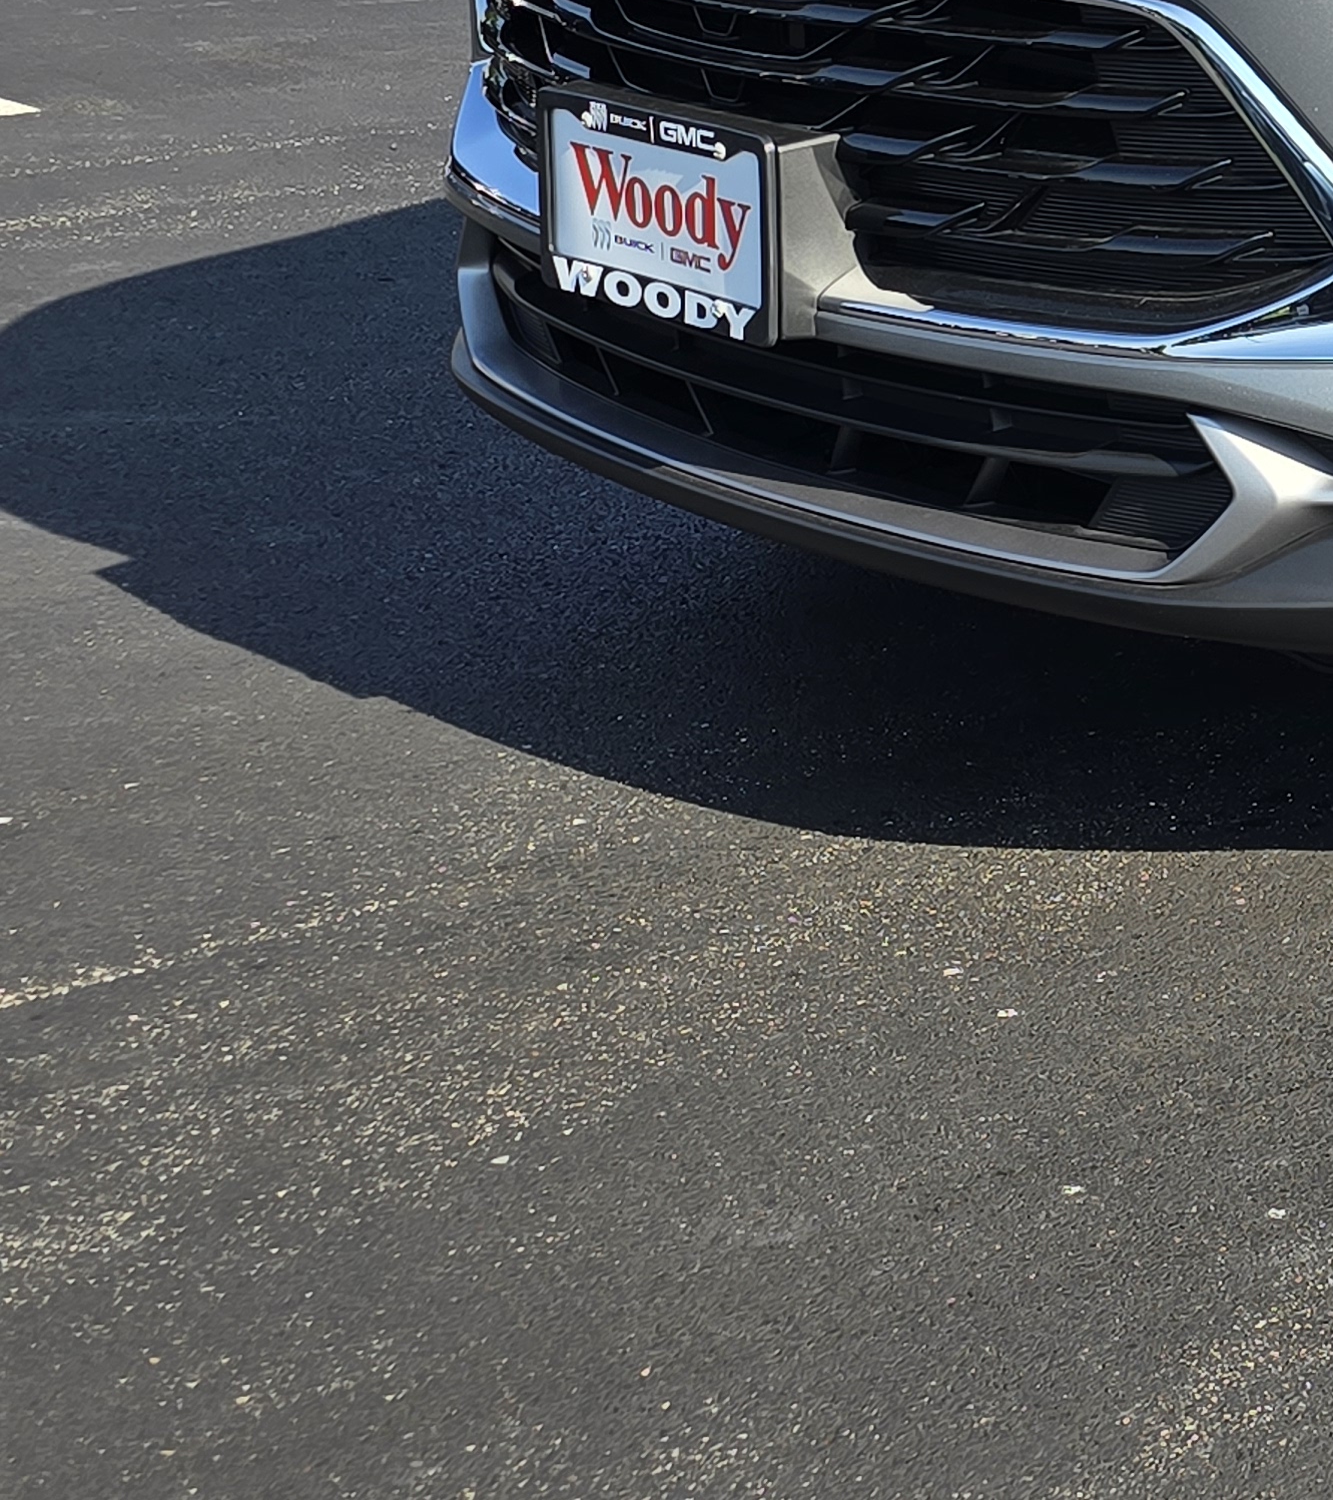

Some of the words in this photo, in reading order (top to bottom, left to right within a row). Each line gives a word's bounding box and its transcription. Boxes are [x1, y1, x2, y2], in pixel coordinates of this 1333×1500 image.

[610, 113, 647, 131] BUICK
[659, 120, 716, 151] GMC
[569, 141, 751, 271] Woody
[614, 235, 655, 254] BUICK
[670, 247, 711, 273] GMC
[552, 255, 757, 340] WOODY
